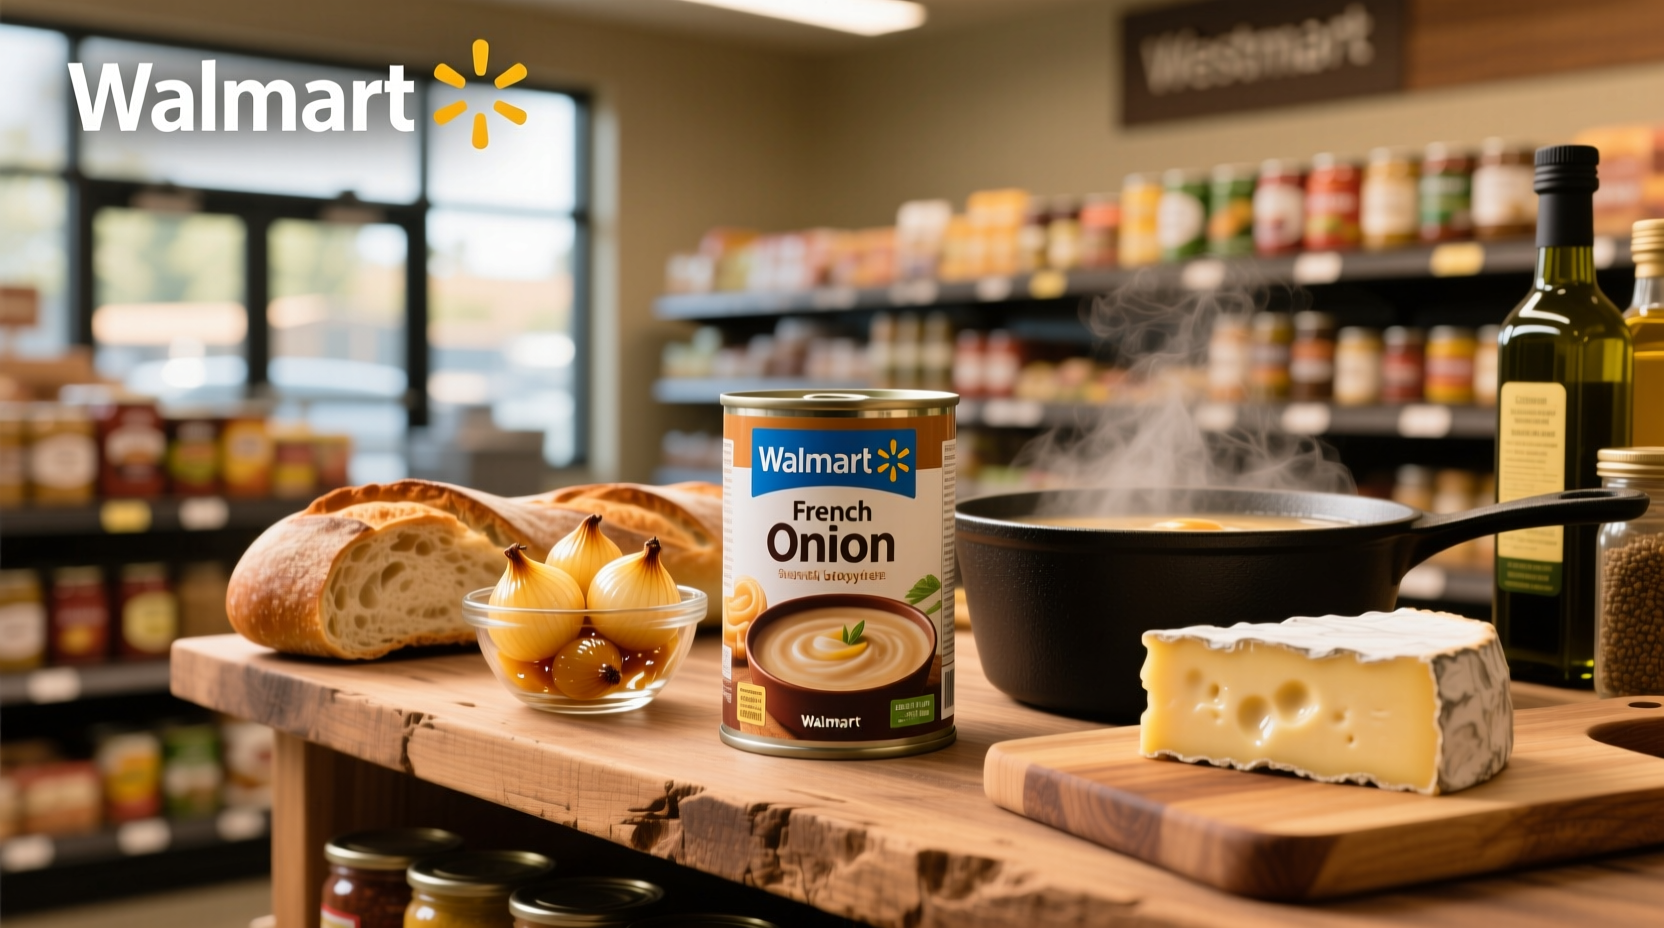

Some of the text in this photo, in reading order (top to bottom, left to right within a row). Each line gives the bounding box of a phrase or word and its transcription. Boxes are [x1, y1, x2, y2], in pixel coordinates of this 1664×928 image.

[758, 446, 872, 474] Walmart
[793, 500, 872, 521] French
[767, 522, 895, 563] Onion
